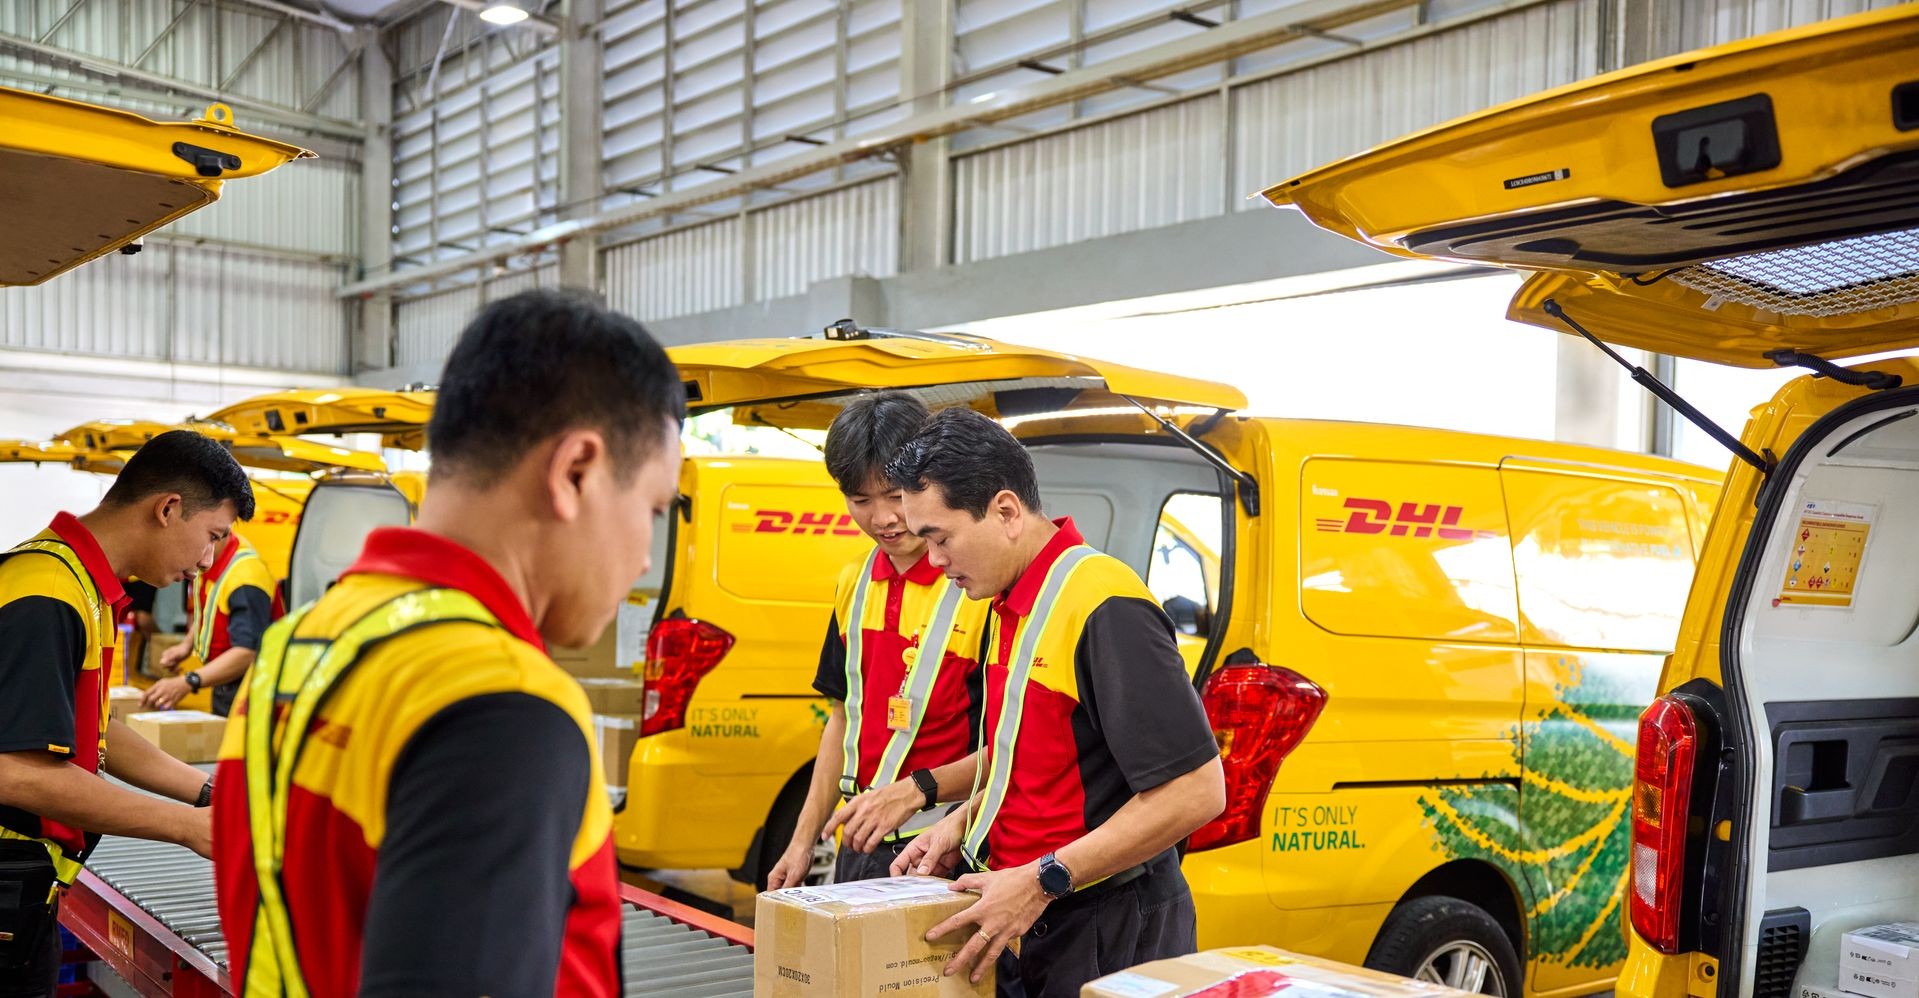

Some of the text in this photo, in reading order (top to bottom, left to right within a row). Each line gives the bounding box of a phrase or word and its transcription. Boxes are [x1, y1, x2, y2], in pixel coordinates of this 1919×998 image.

[755, 510, 860, 536] DHL
[1343, 497, 1473, 540] DHL
[721, 706, 758, 721] ONLY
[1313, 805, 1358, 825] ONLY
[1272, 830, 1365, 852] NATURAL.
[879, 975, 940, 993] Precision Mould
